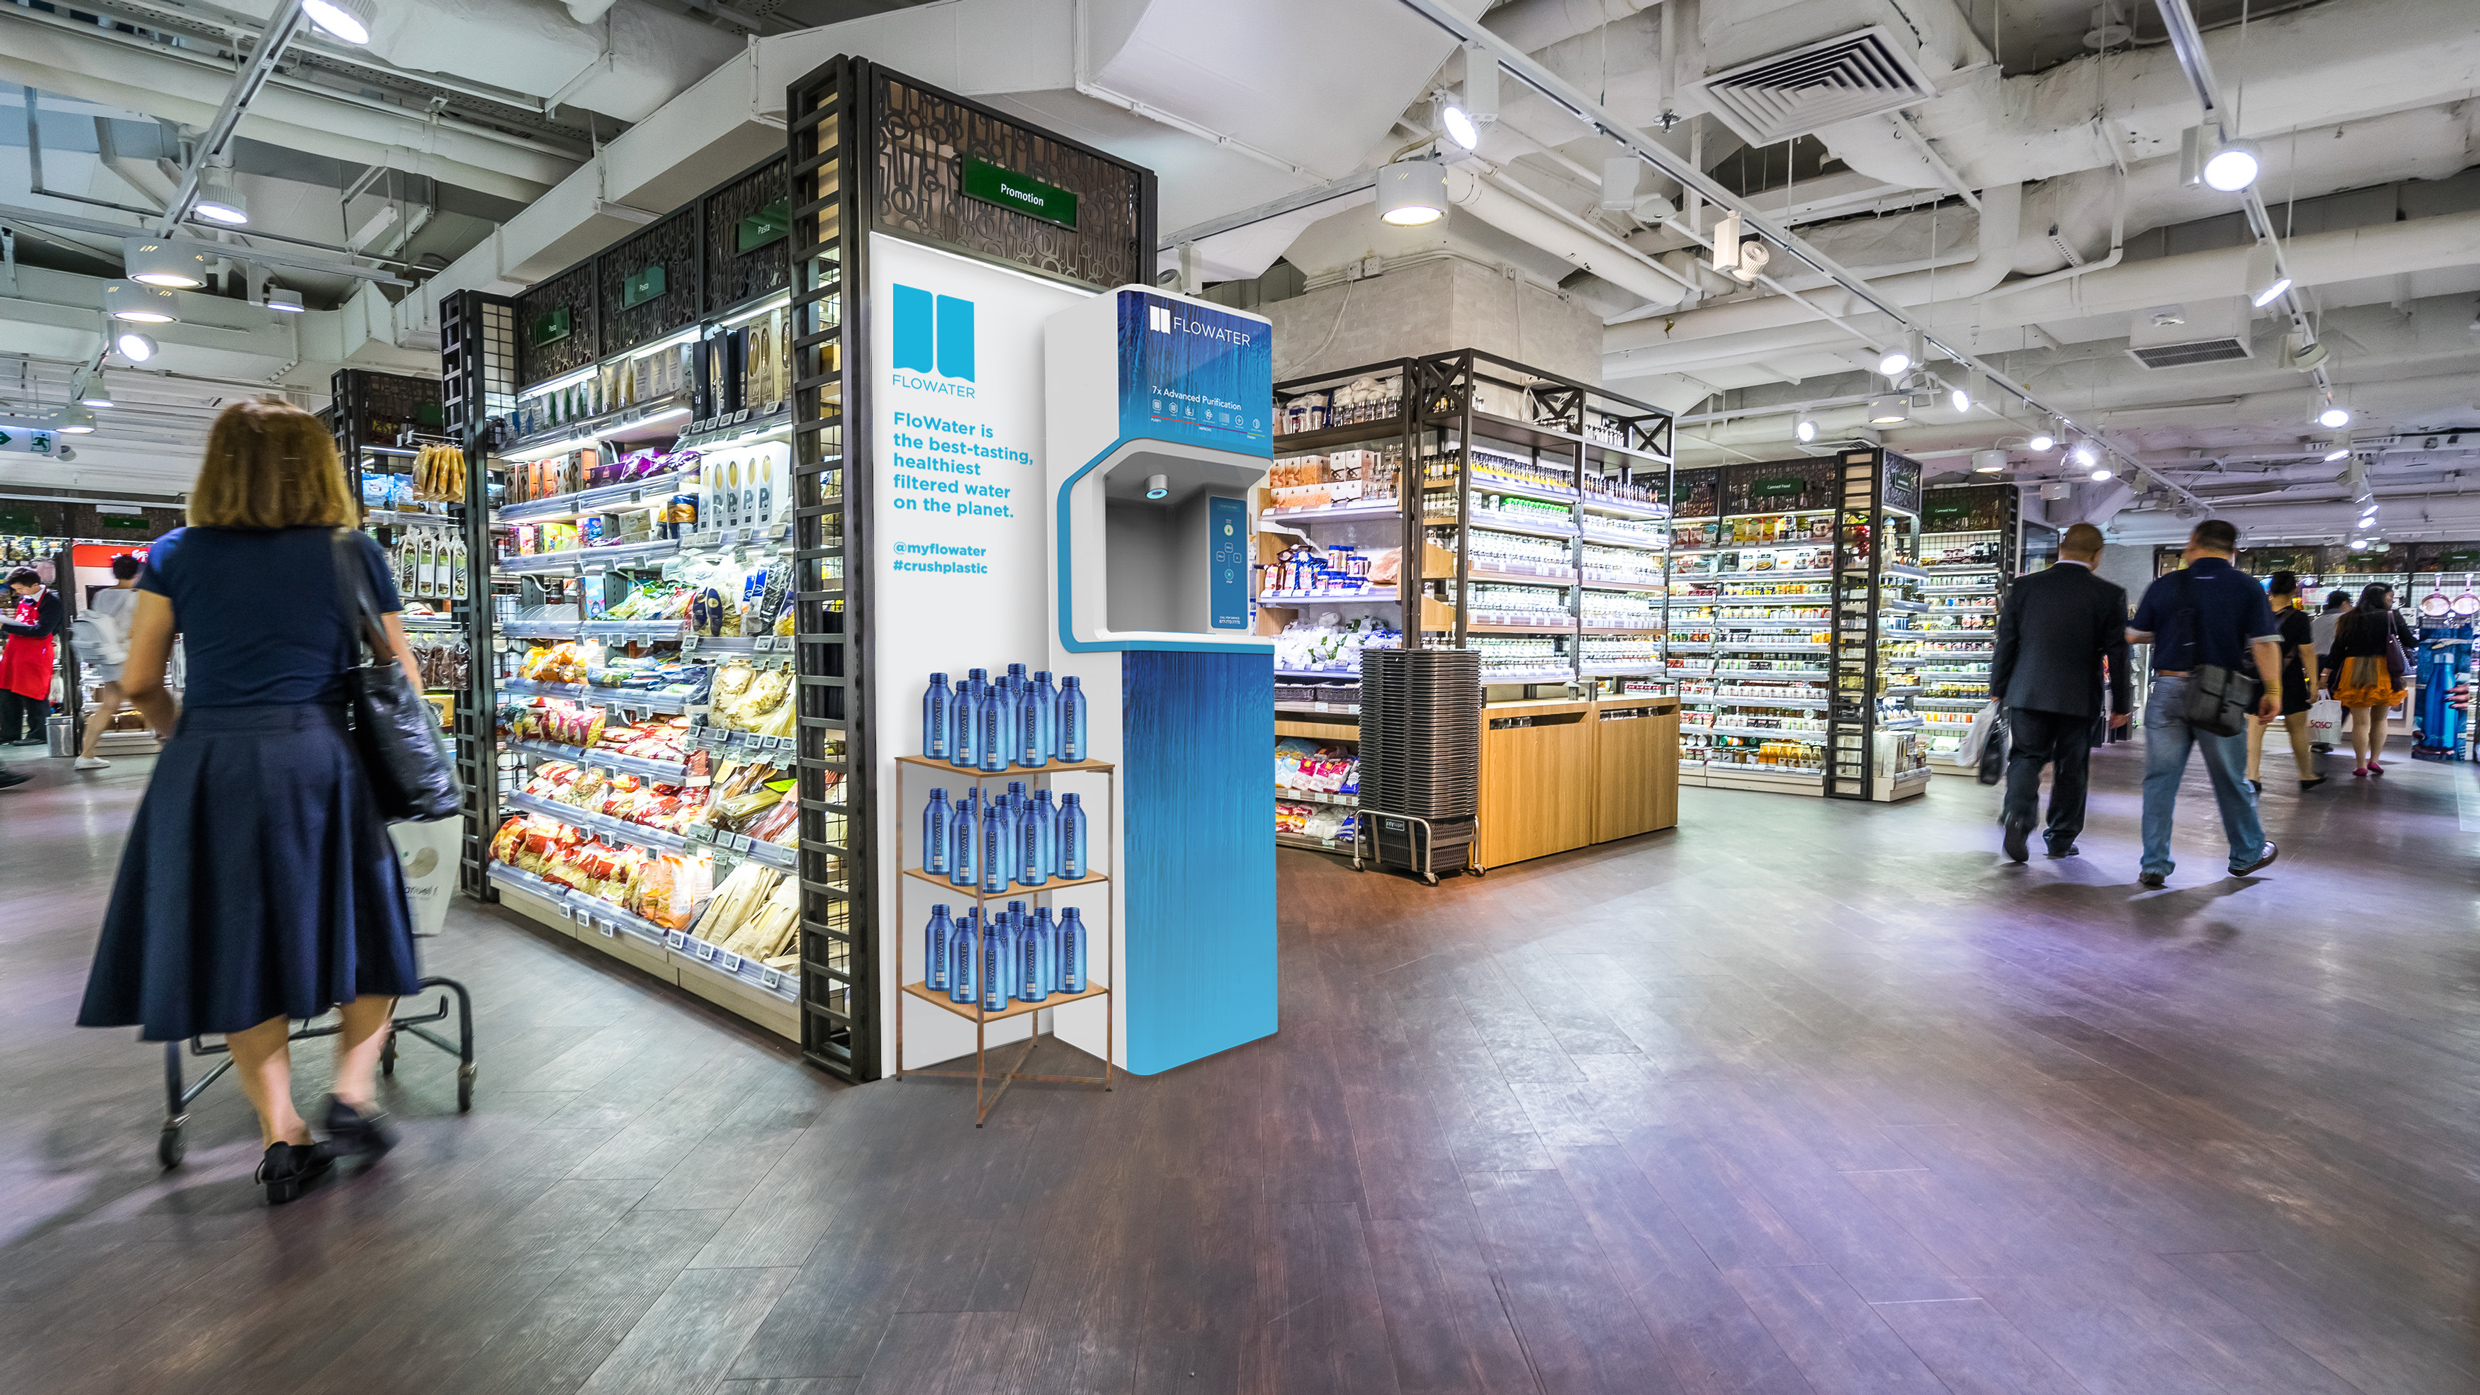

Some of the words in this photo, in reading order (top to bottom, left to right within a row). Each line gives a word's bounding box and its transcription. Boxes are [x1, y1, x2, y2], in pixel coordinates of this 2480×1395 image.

[1001, 183, 1044, 206] Promotion
[758, 224, 770, 235] Pasta
[1173, 316, 1251, 348] FLOWATER
[892, 374, 975, 399] FLOWATER
[1152, 385, 1162, 396] 7x
[1163, 388, 1200, 403] Advanced
[1202, 396, 1242, 411] Purification
[894, 411, 976, 437] FloWater
[981, 424, 994, 438] is
[893, 433, 923, 449] the
[929, 436, 1034, 466] best-tasting,
[893, 453, 981, 476] healthiest
[893, 474, 959, 495] filtered
[964, 484, 1011, 498] water
[893, 497, 917, 510] on
[923, 498, 951, 513] the
[957, 501, 1014, 518] planet.
[893, 541, 986, 557] @myflowater
[893, 560, 988, 575] #crushplastic
